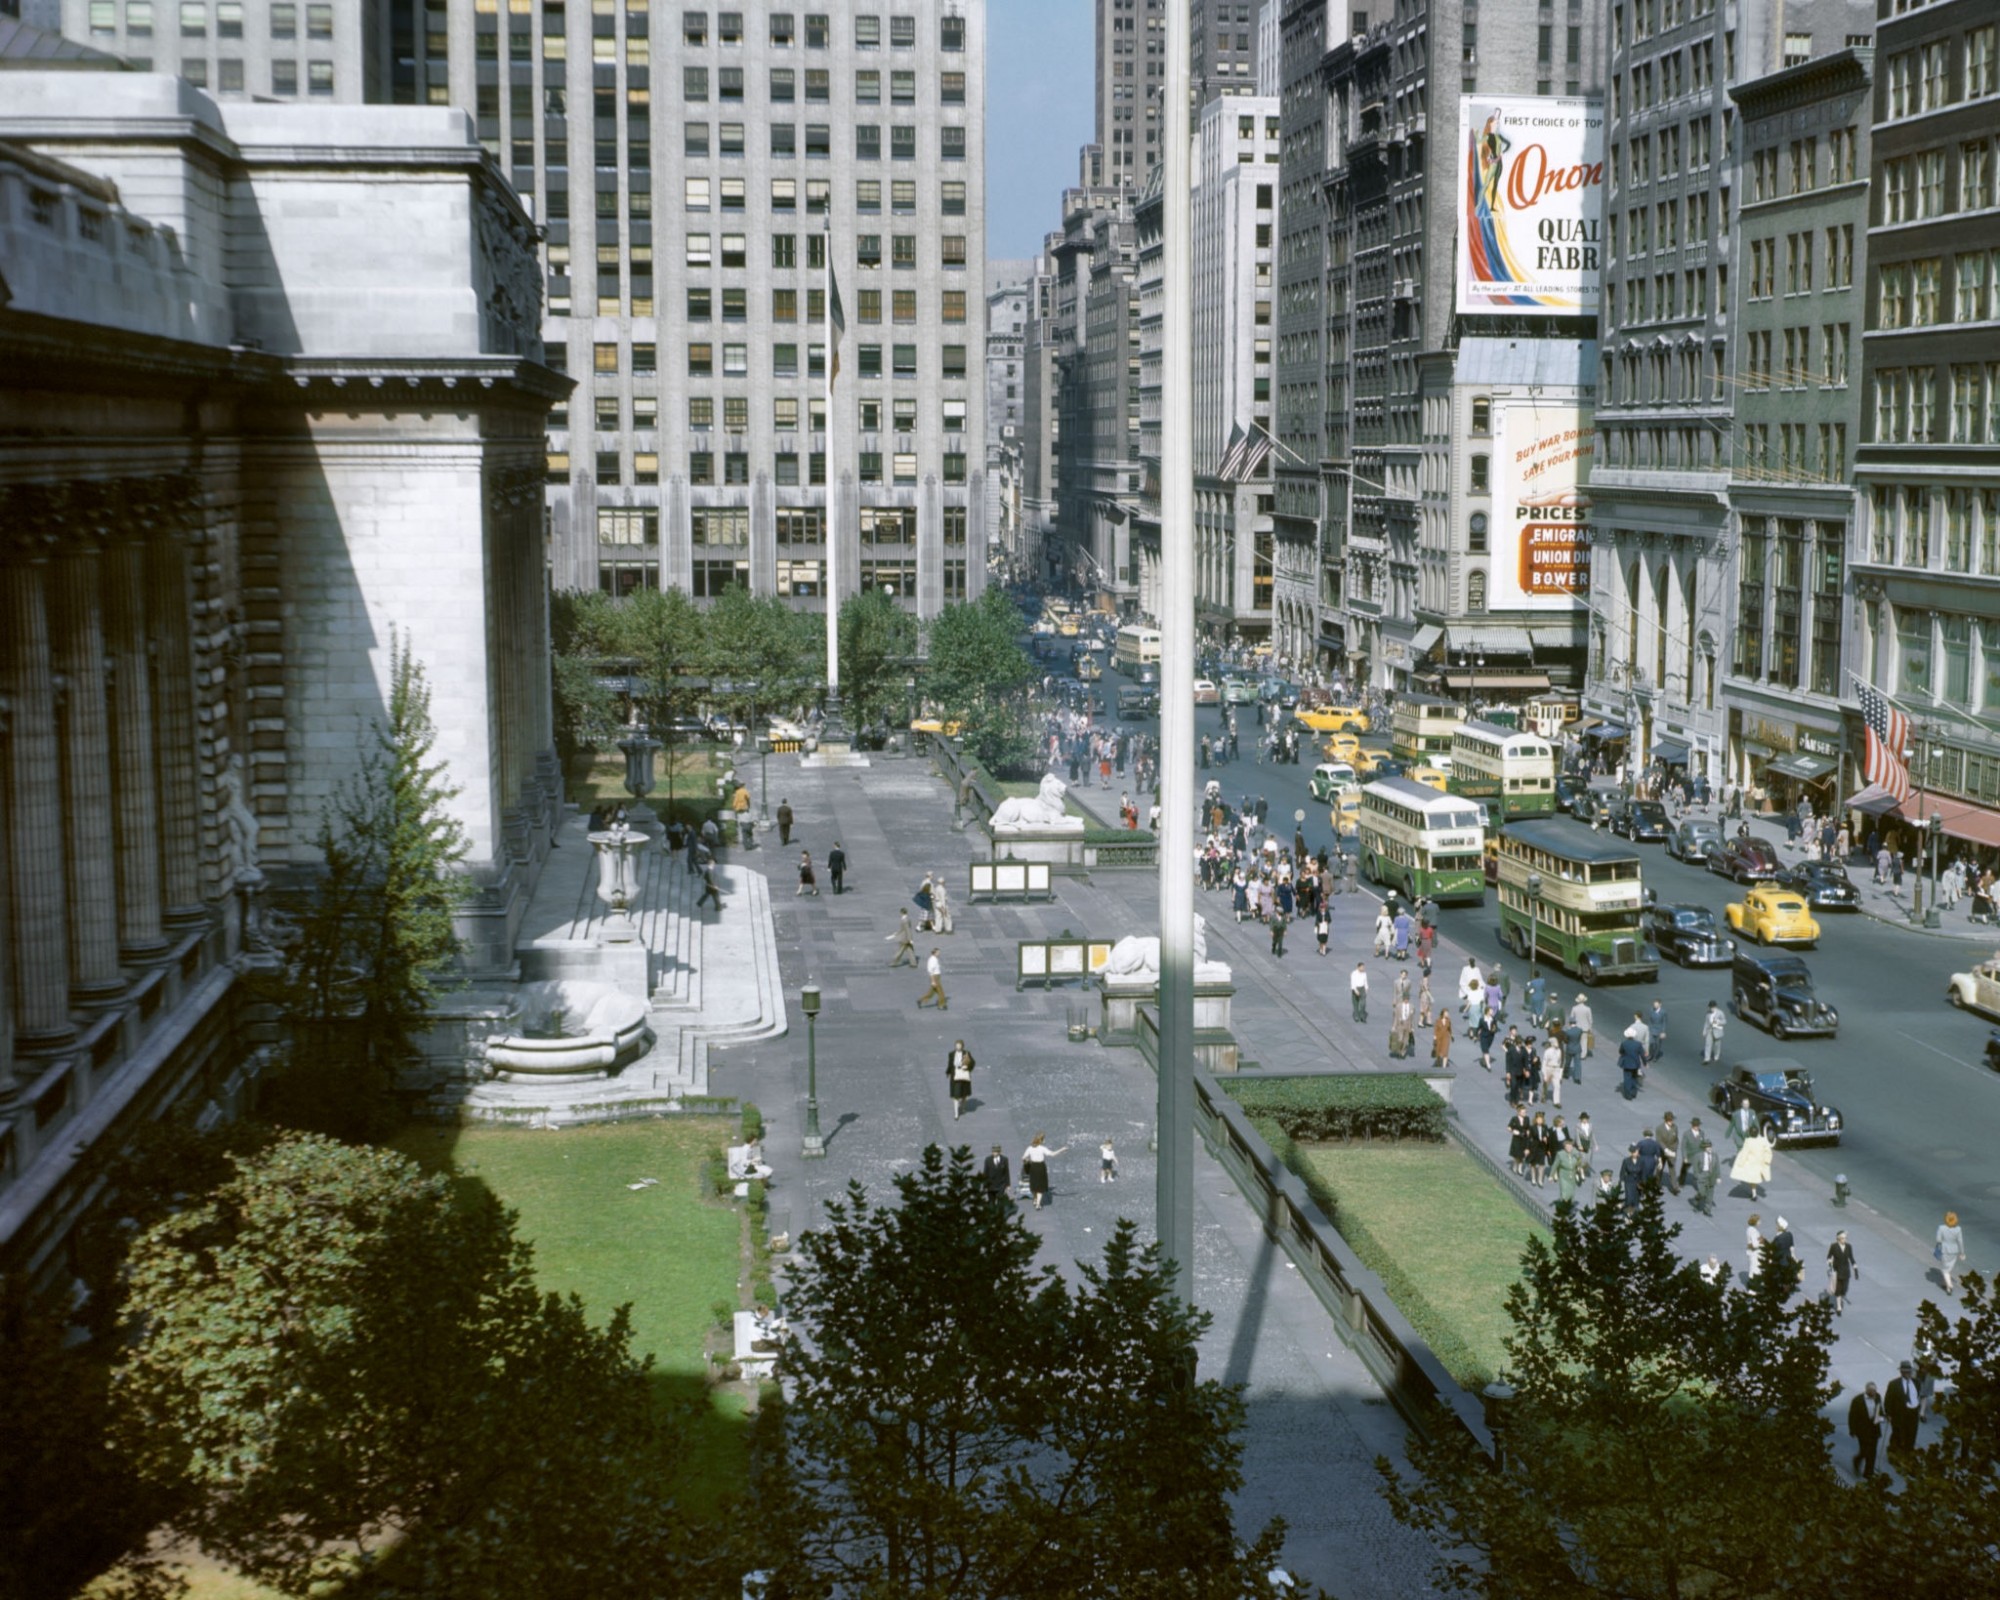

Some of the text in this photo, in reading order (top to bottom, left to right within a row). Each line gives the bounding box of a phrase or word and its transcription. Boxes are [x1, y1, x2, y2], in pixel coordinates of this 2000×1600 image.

[1504, 116, 1603, 128] FIRST CHOICE OF TOP
[1507, 143, 1603, 210] Onon
[1538, 218, 1601, 244] QUAL
[1536, 246, 1600, 271] FABR
[1516, 427, 1595, 463] BUY WAR BONDS
[1523, 460, 1545, 481] SAVE
[1547, 451, 1572, 468] YOUR
[1516, 507, 1586, 520] PRICES
[1533, 550, 1571, 564] UNION
[1532, 572, 1588, 585] BOWER
